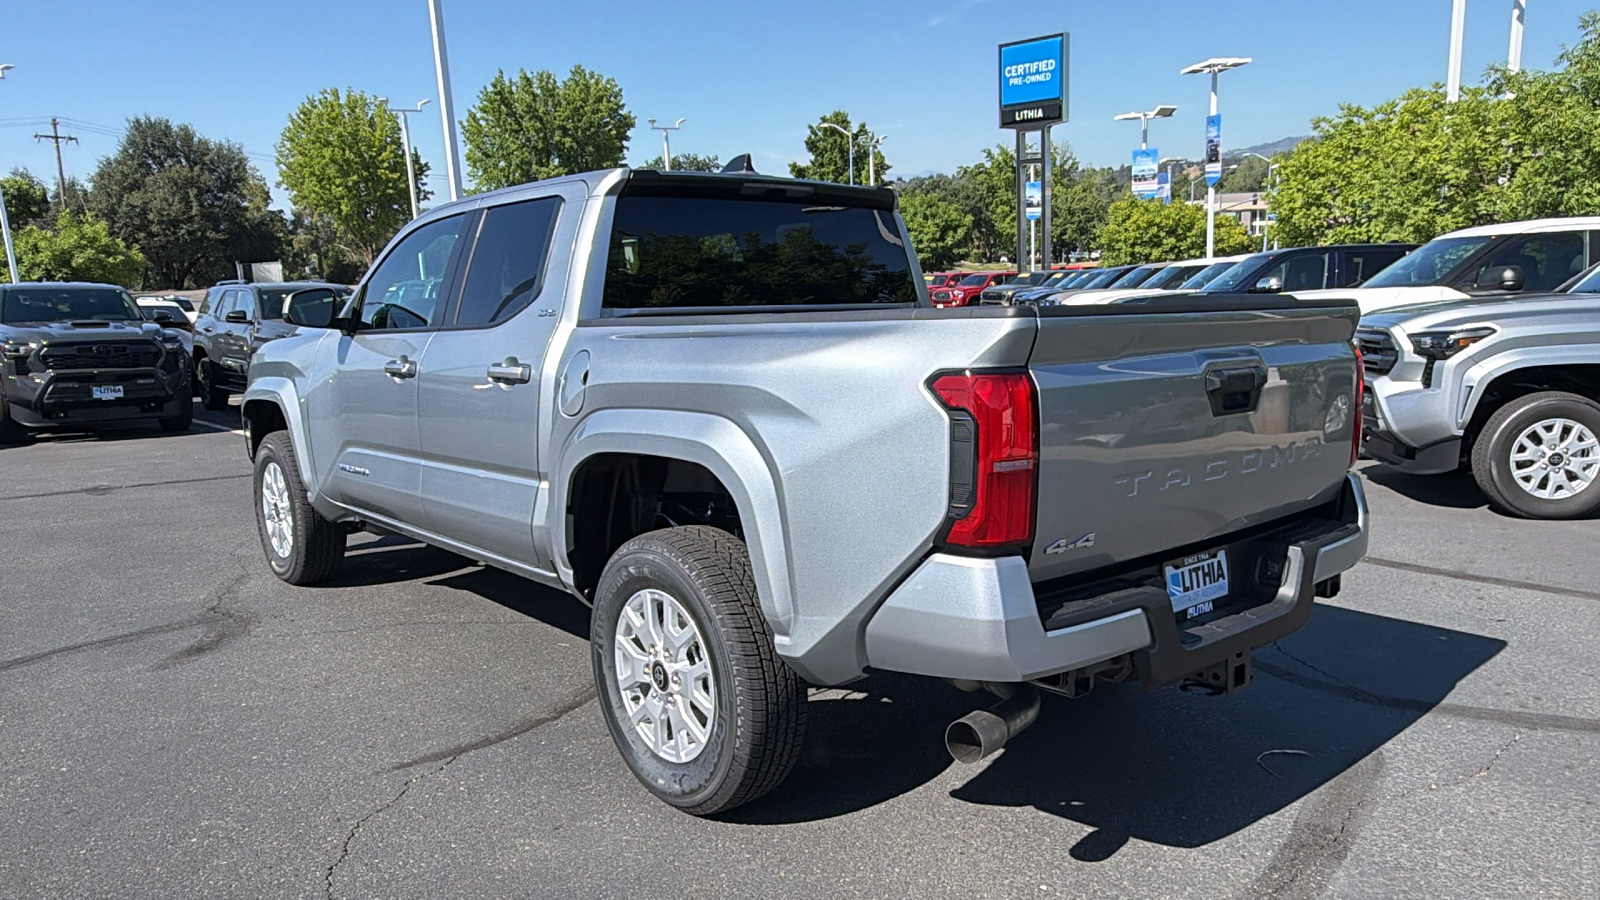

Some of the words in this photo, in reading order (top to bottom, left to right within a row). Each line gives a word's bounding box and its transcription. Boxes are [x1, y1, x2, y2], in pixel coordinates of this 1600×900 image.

[1005, 59, 1056, 78] CERTIFIED
[1009, 73, 1052, 87] PRE-OWNED
[1015, 108, 1043, 121] LITHIA
[1114, 437, 1322, 498] TACOMA
[1184, 555, 1198, 566] SINCE
[1198, 552, 1209, 562] 1946
[1181, 560, 1226, 593] LITHIA
[1193, 601, 1213, 616] LITHIA
